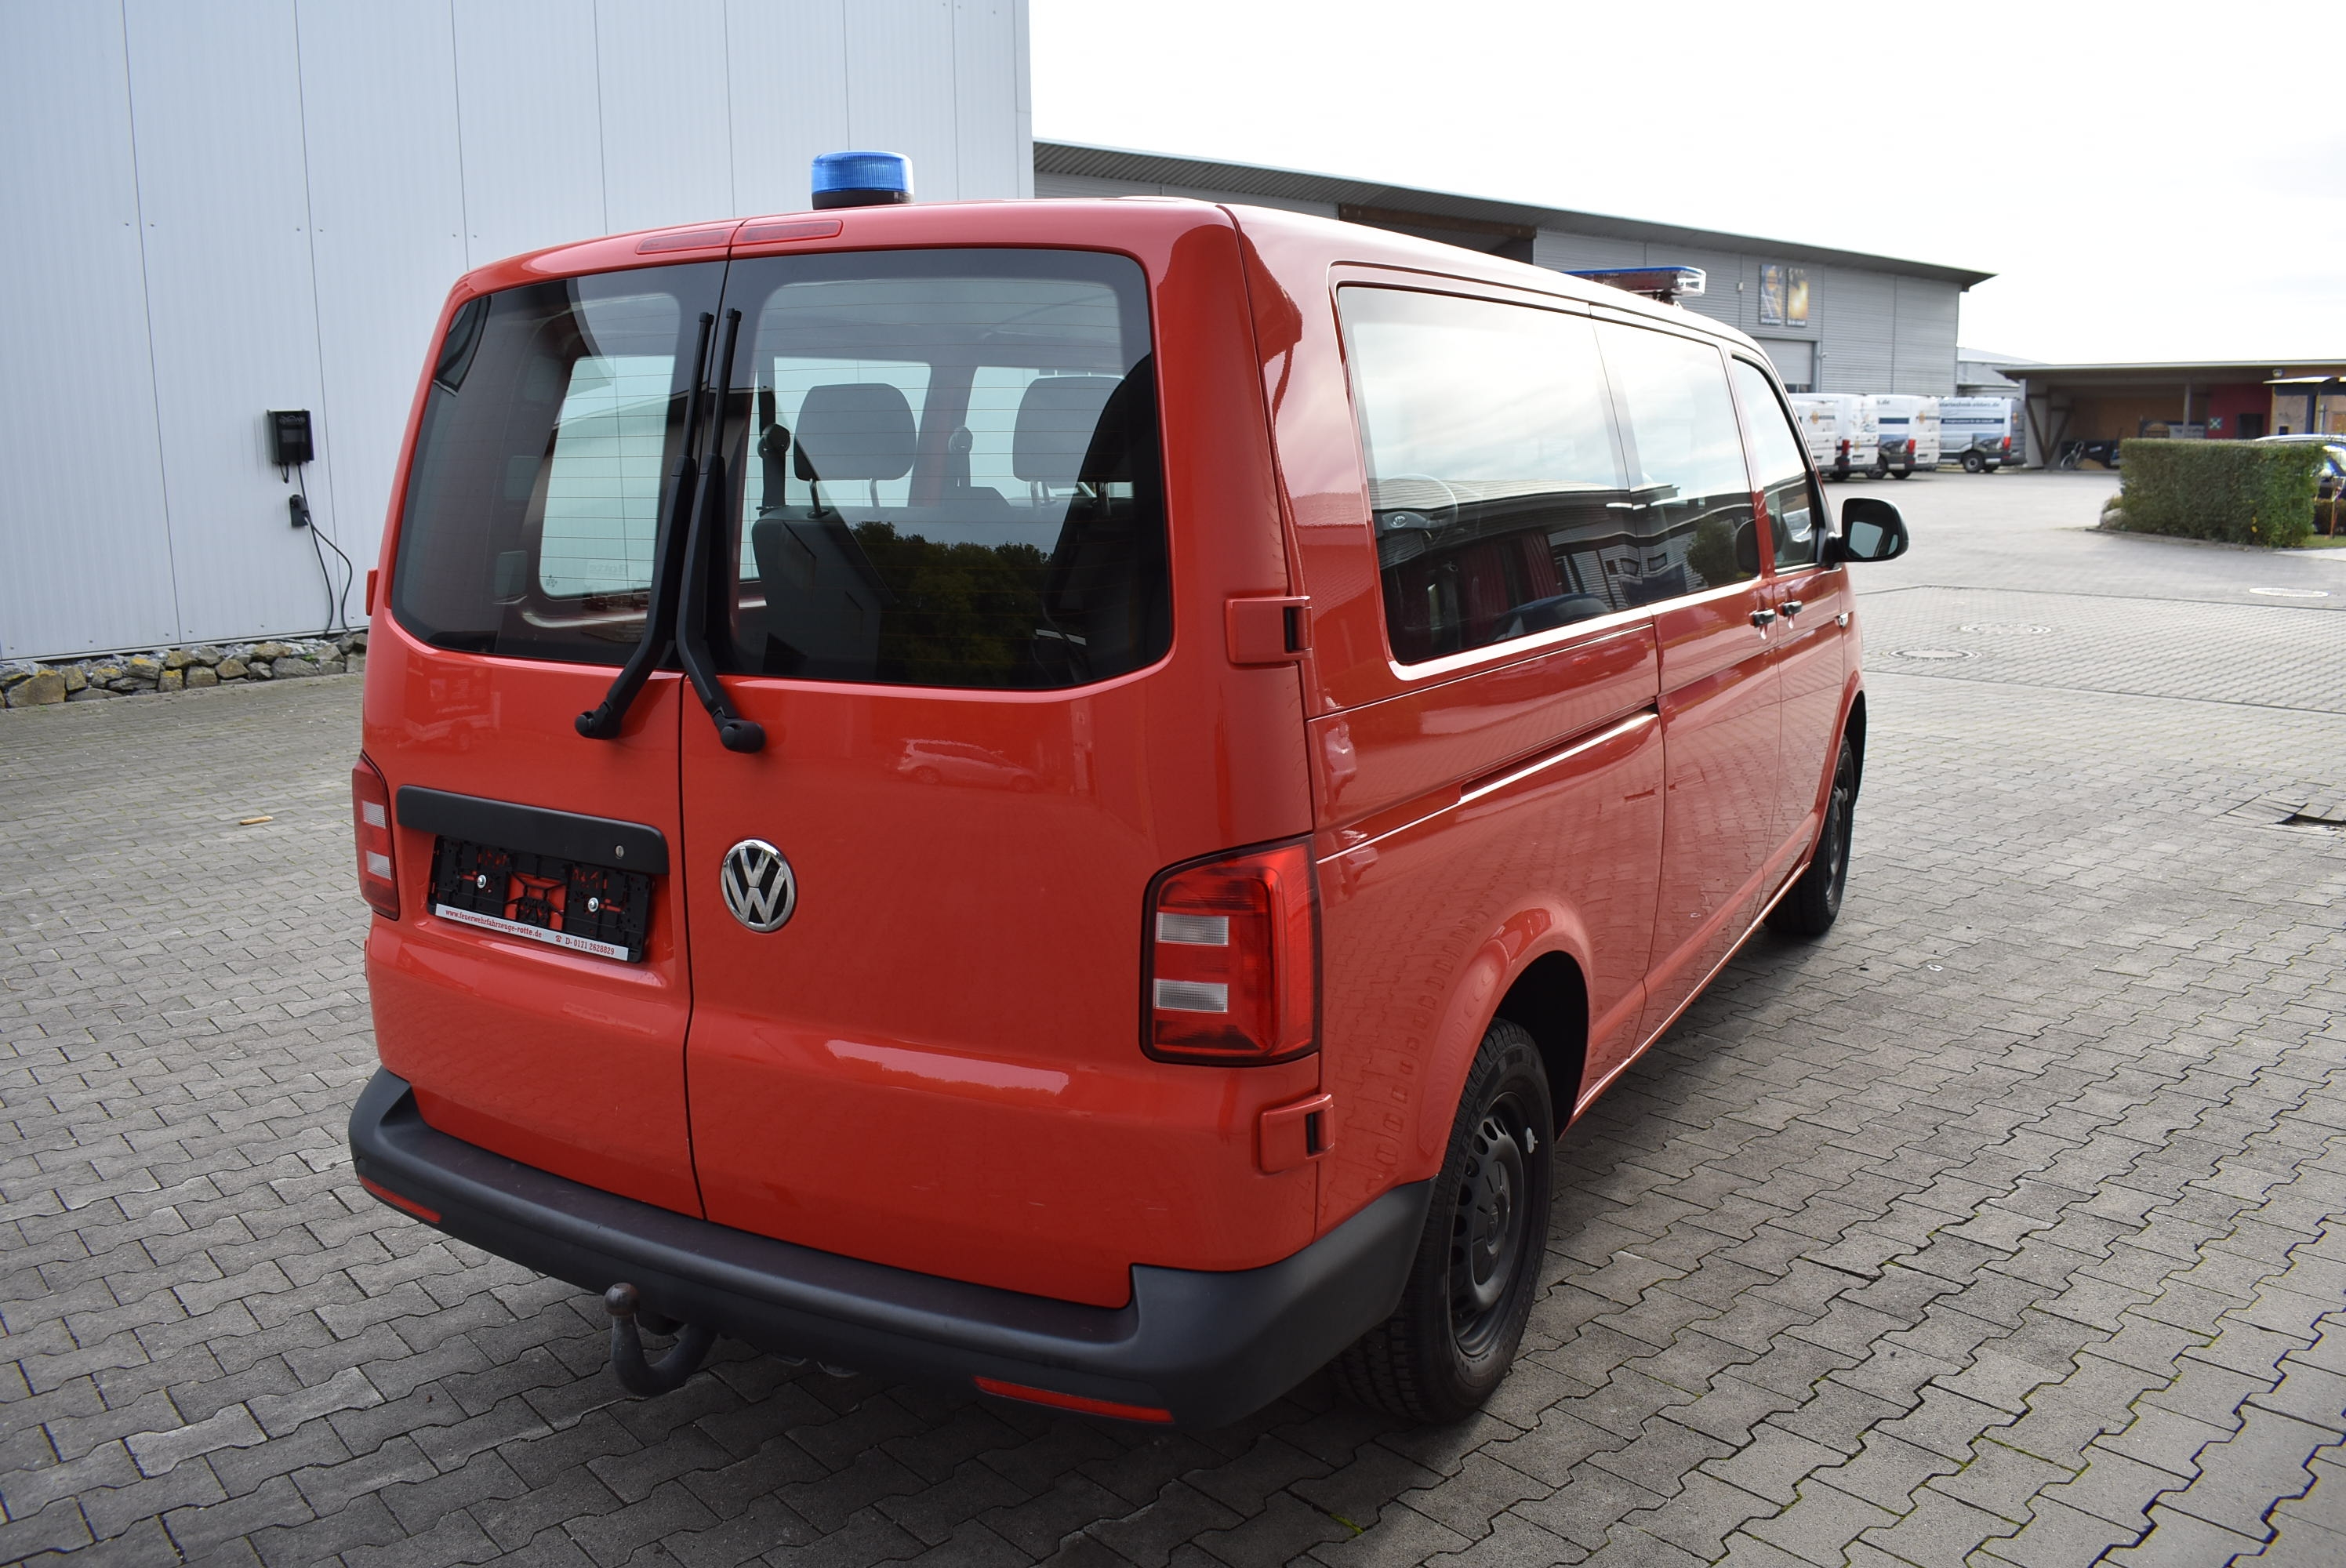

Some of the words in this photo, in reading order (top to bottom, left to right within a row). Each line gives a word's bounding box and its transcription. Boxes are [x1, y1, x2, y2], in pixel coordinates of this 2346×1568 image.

[445, 909, 543, 938] www.feuerwehrfahrzeuge-rotte.de
[573, 938, 587, 949] 0171
[589, 942, 615, 955] 2628829
[1461, 1134, 1470, 1150] R
[1468, 1112, 1478, 1132] 16
[1476, 1098, 1484, 1112] C
